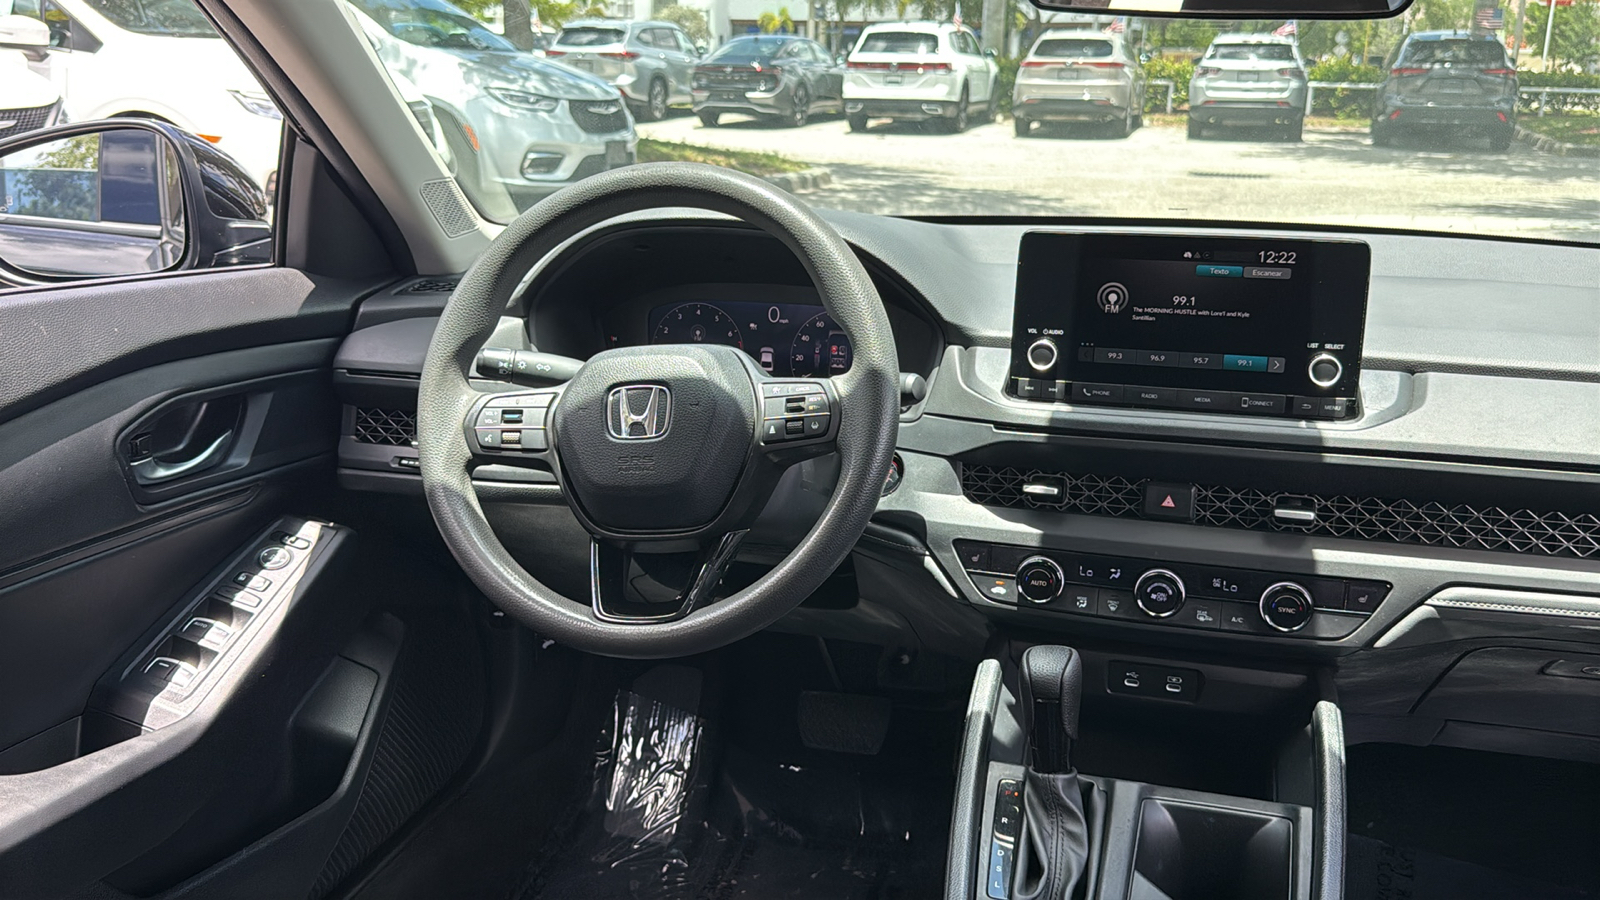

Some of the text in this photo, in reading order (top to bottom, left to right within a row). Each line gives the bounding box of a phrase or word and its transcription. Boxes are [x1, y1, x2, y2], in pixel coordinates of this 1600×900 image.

[1259, 250, 1297, 264] 12:22
[1210, 267, 1229, 275] Texto
[1252, 269, 1283, 277] Escanear
[1172, 295, 1196, 306] 99.1
[1104, 304, 1119, 314] FM
[768, 306, 780, 323] 0
[816, 320, 825, 328] 60
[663, 326, 669, 334] 2
[1150, 354, 1165, 362] 96.9
[1193, 357, 1209, 365] 95.7
[1237, 359, 1252, 367] 99.1
[1030, 579, 1048, 587] AUTO
[1277, 606, 1297, 614] SYNC
[997, 849, 1004, 857] D
